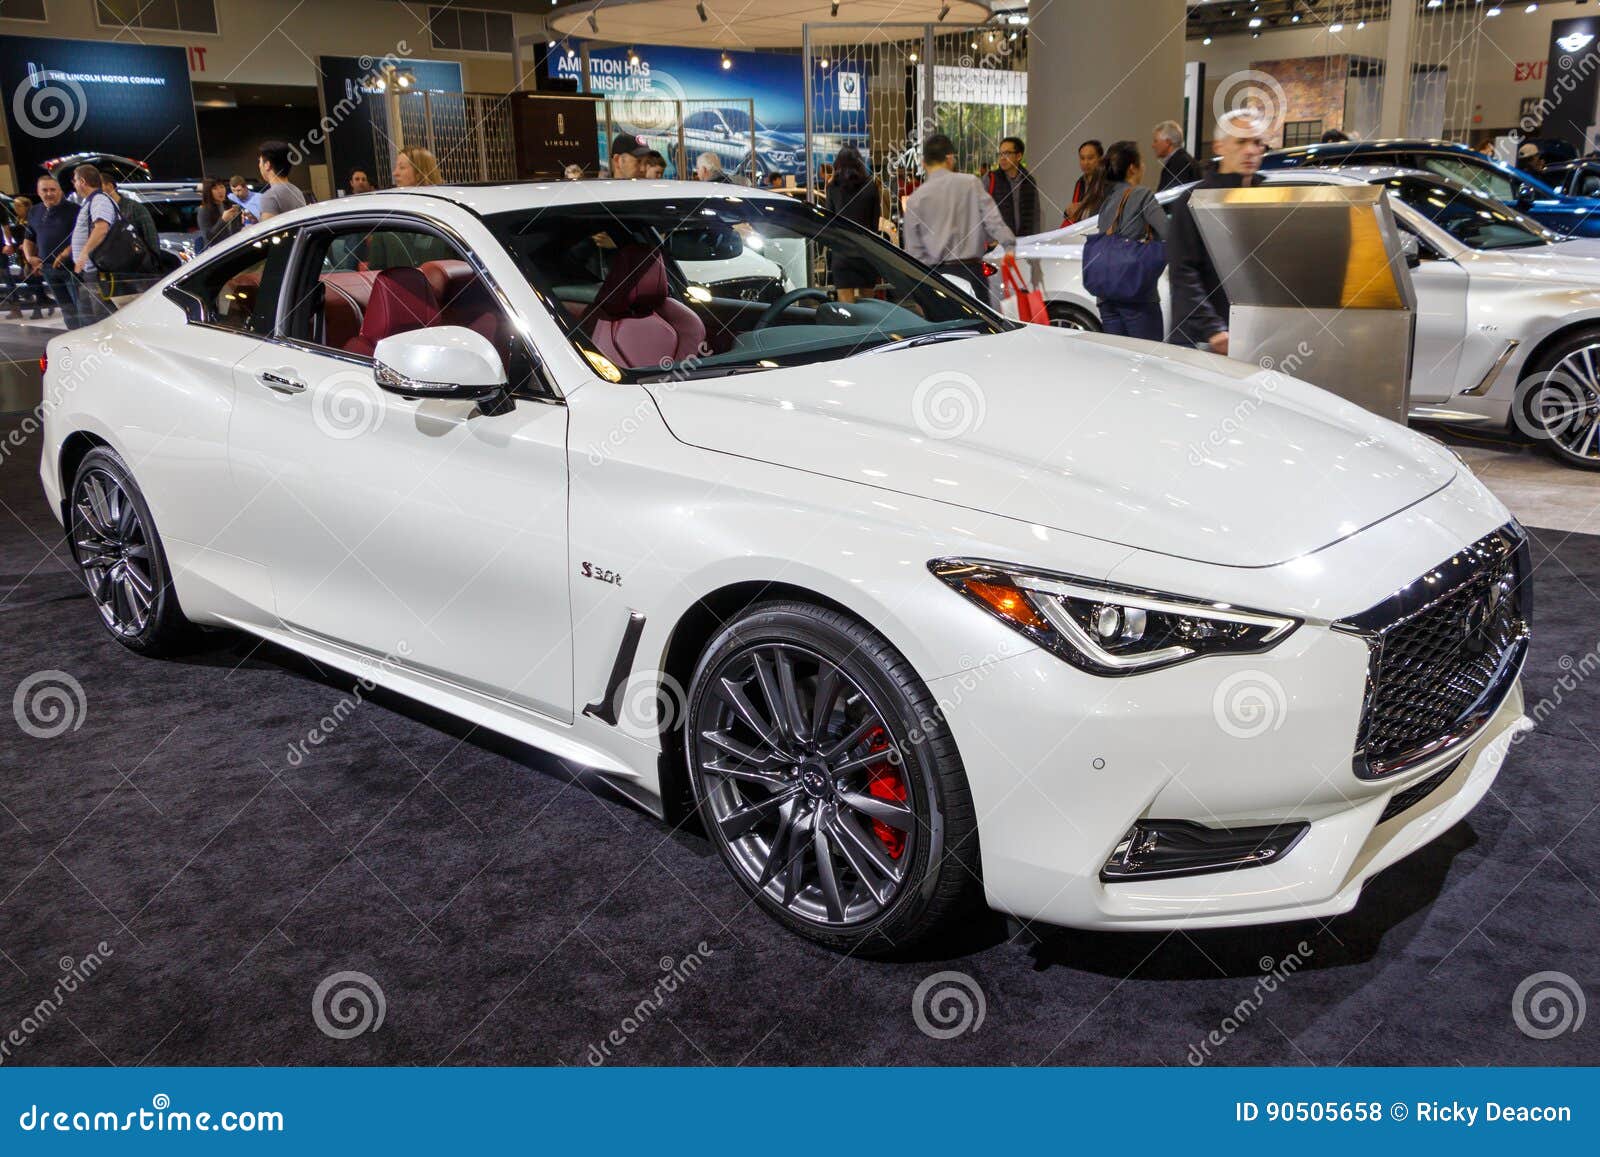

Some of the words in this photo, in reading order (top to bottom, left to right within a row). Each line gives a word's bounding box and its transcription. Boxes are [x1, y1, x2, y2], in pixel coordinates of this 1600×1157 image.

[188, 47, 207, 72] IT
[558, 56, 622, 74] AMITION
[624, 60, 650, 76] HAS
[49, 72, 65, 80] THE
[66, 73, 101, 82] LINCOLN
[102, 75, 129, 84] MOTOR
[130, 76, 165, 86] COMPANY
[1514, 60, 1549, 82] EXI
[589, 75, 623, 91] INISH
